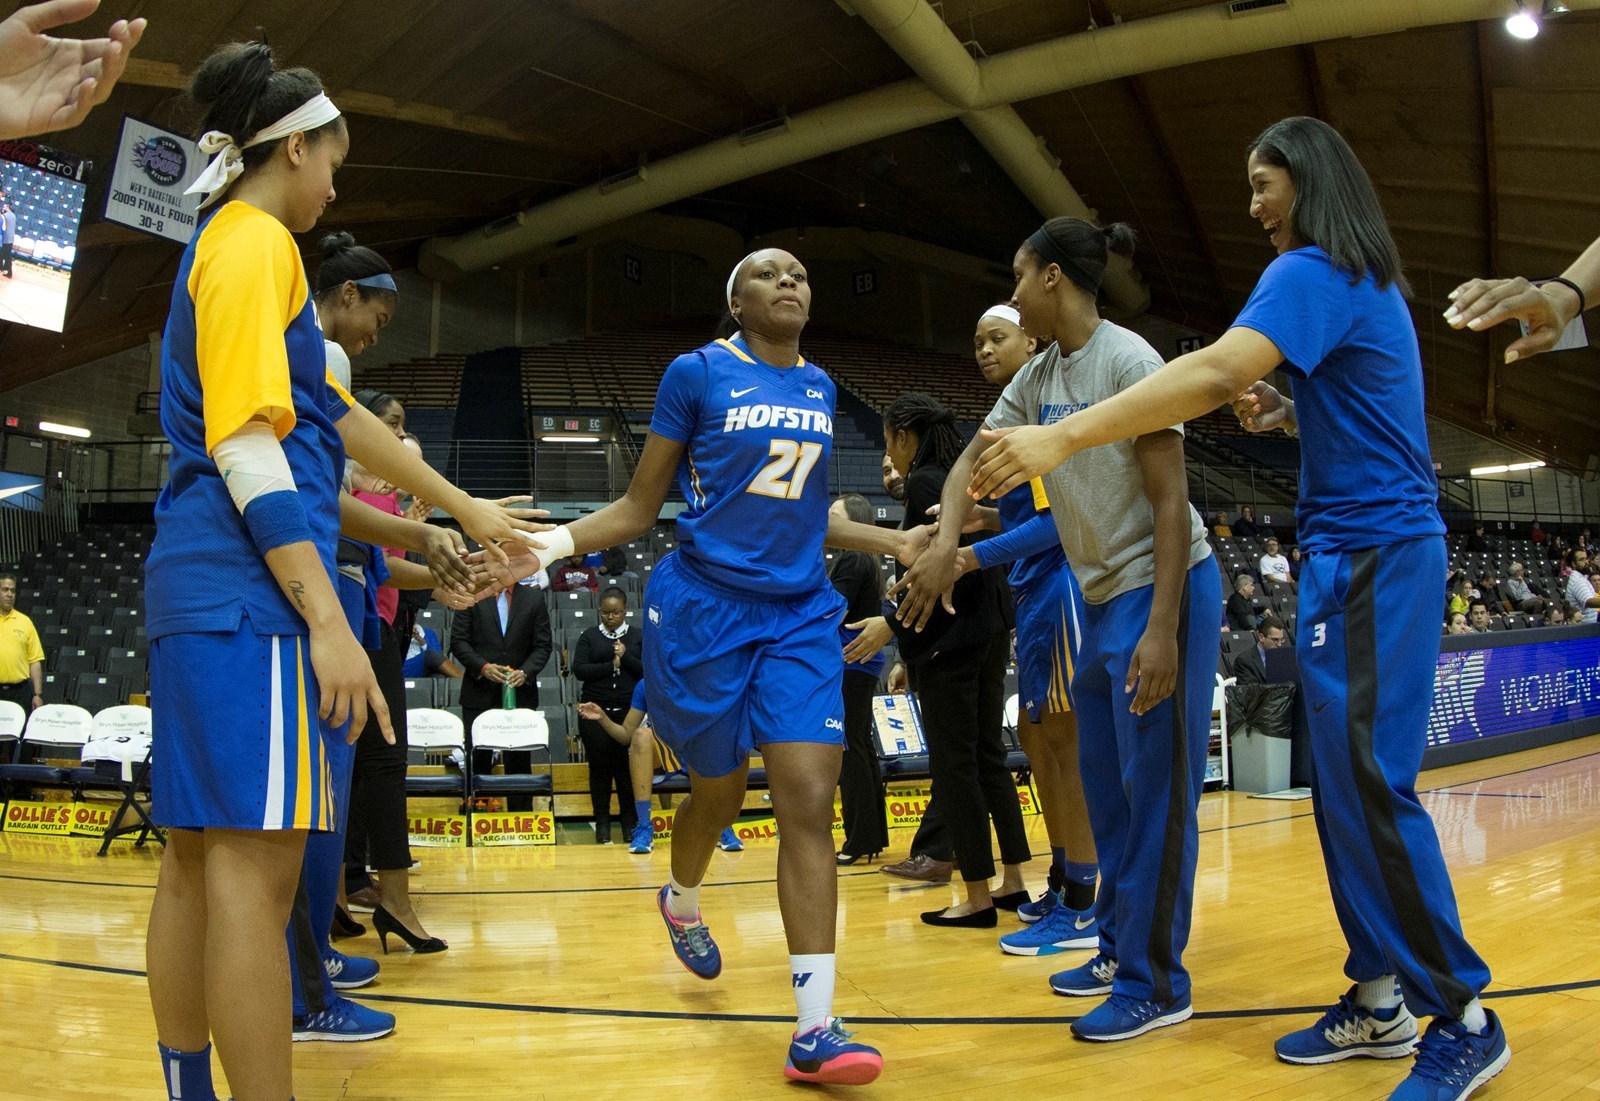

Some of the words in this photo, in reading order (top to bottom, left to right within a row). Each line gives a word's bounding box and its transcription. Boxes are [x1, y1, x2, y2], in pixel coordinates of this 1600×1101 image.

[38, 157, 72, 175] zero
[141, 149, 181, 177] FOUR
[130, 181, 147, 196] MEN'S
[148, 188, 182, 208] BASKETBALL
[112, 189, 137, 207] 2009
[138, 198, 166, 217] FINAL
[168, 209, 194, 226] FOUR
[139, 214, 164, 232] 30-8
[543, 417, 554, 427] ED
[589, 419, 600, 428] EC
[745, 438, 823, 500] 21
[878, 508, 887, 518] E3
[1312, 622, 1326, 647] 3
[825, 718, 843, 731] CAA
[7, 822, 39, 830] BARGAIN
[40, 823, 67, 831] OUTLET
